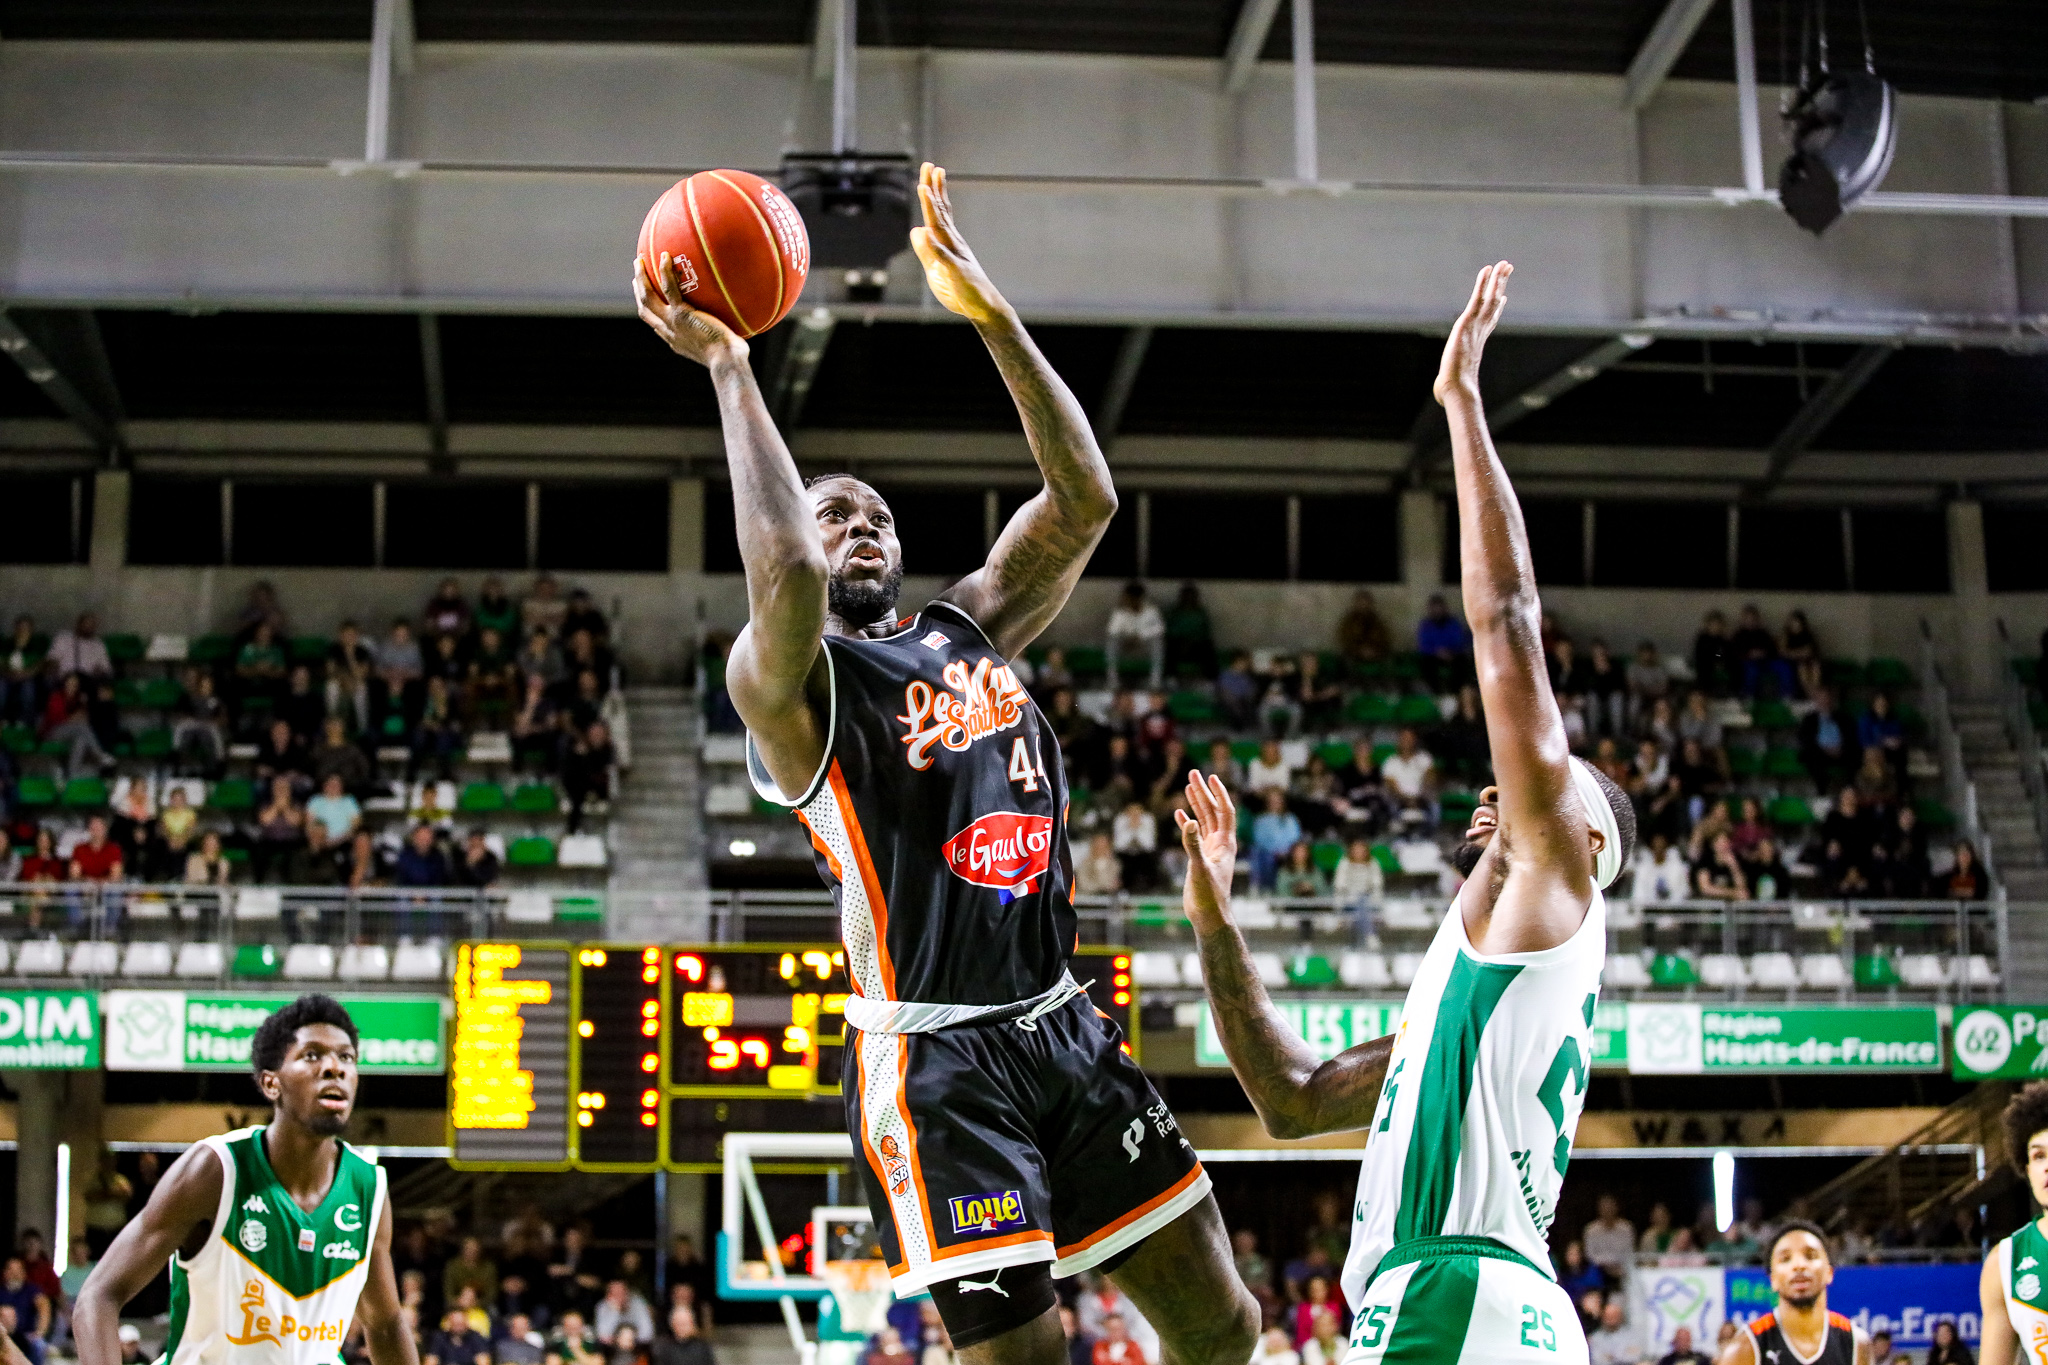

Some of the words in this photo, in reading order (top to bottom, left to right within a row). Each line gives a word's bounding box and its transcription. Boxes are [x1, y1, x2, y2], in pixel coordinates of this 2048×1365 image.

[896, 680, 956, 771] Le
[941, 687, 1022, 751] Sarthe
[952, 843, 967, 865] le
[969, 822, 1051, 876] Gauloi
[1704, 1013, 1782, 1040] Région
[1965, 1025, 2000, 1055] 62
[1704, 1036, 1935, 1064] Hauts-de-France
[954, 1190, 1020, 1228] Loué
[279, 1314, 344, 1343] Portel
[1520, 1304, 1557, 1352] 25
